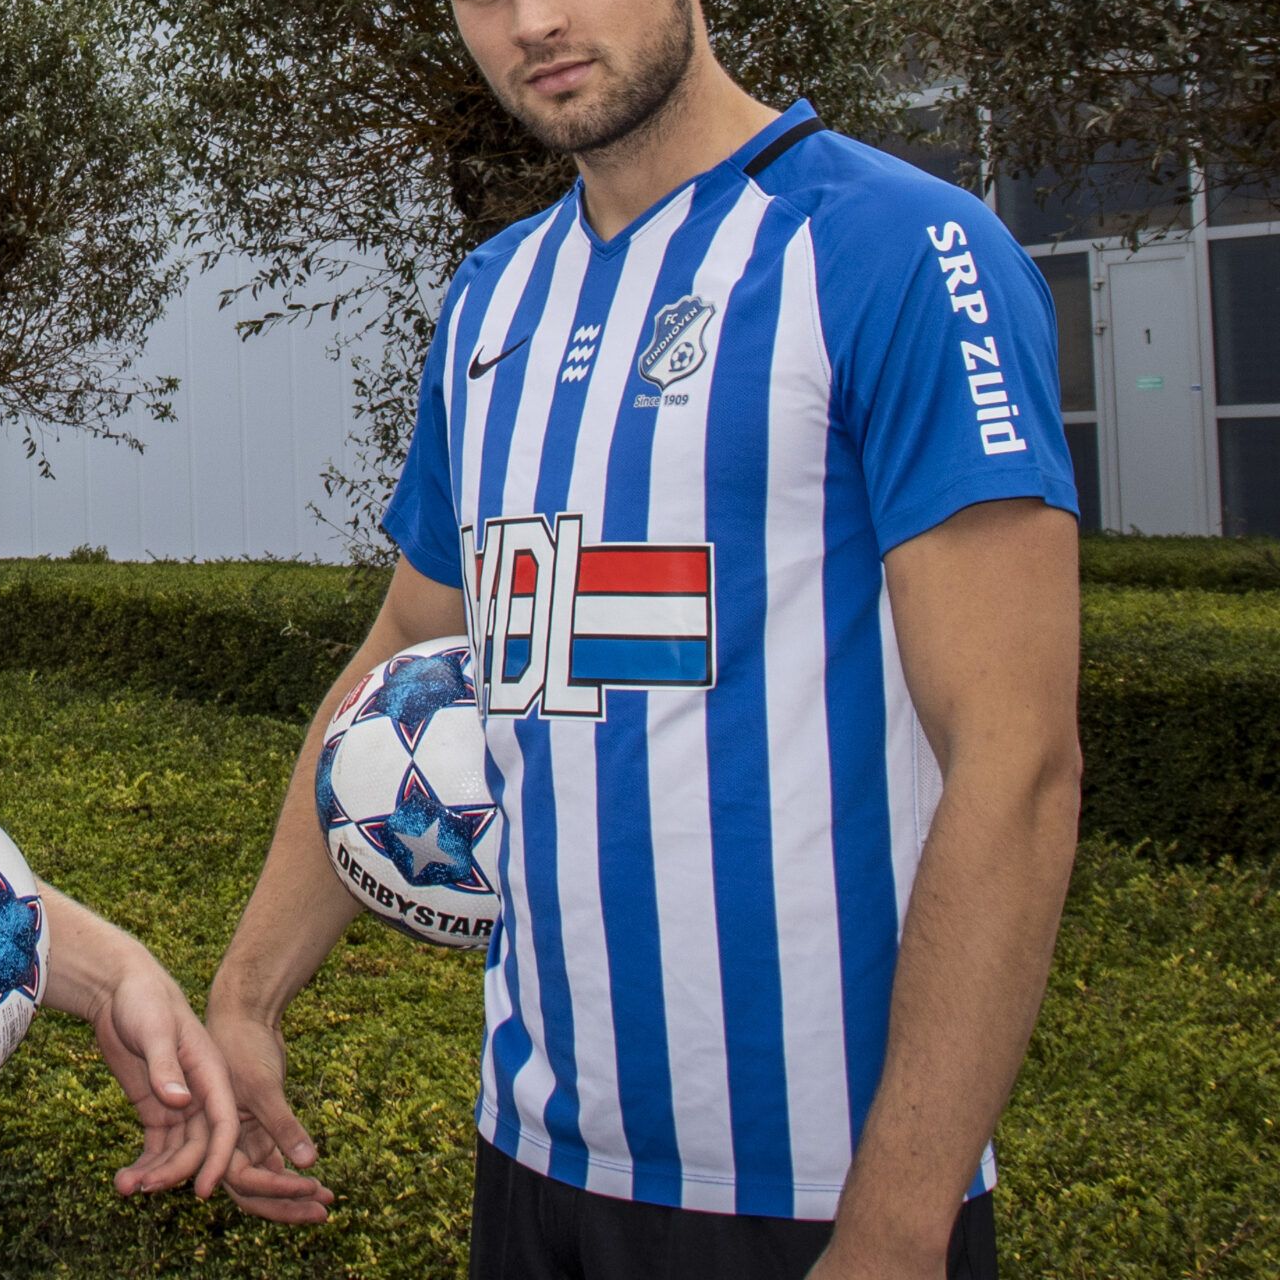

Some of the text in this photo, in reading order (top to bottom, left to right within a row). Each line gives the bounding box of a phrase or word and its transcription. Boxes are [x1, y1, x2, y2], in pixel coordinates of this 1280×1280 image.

[926, 221, 989, 324] SRP
[645, 306, 699, 366] EINDHOVEN
[1145, 328, 1151, 345] 1
[633, 394, 690, 407] Since 1909
[336, 842, 494, 937] DERBYSTAR
